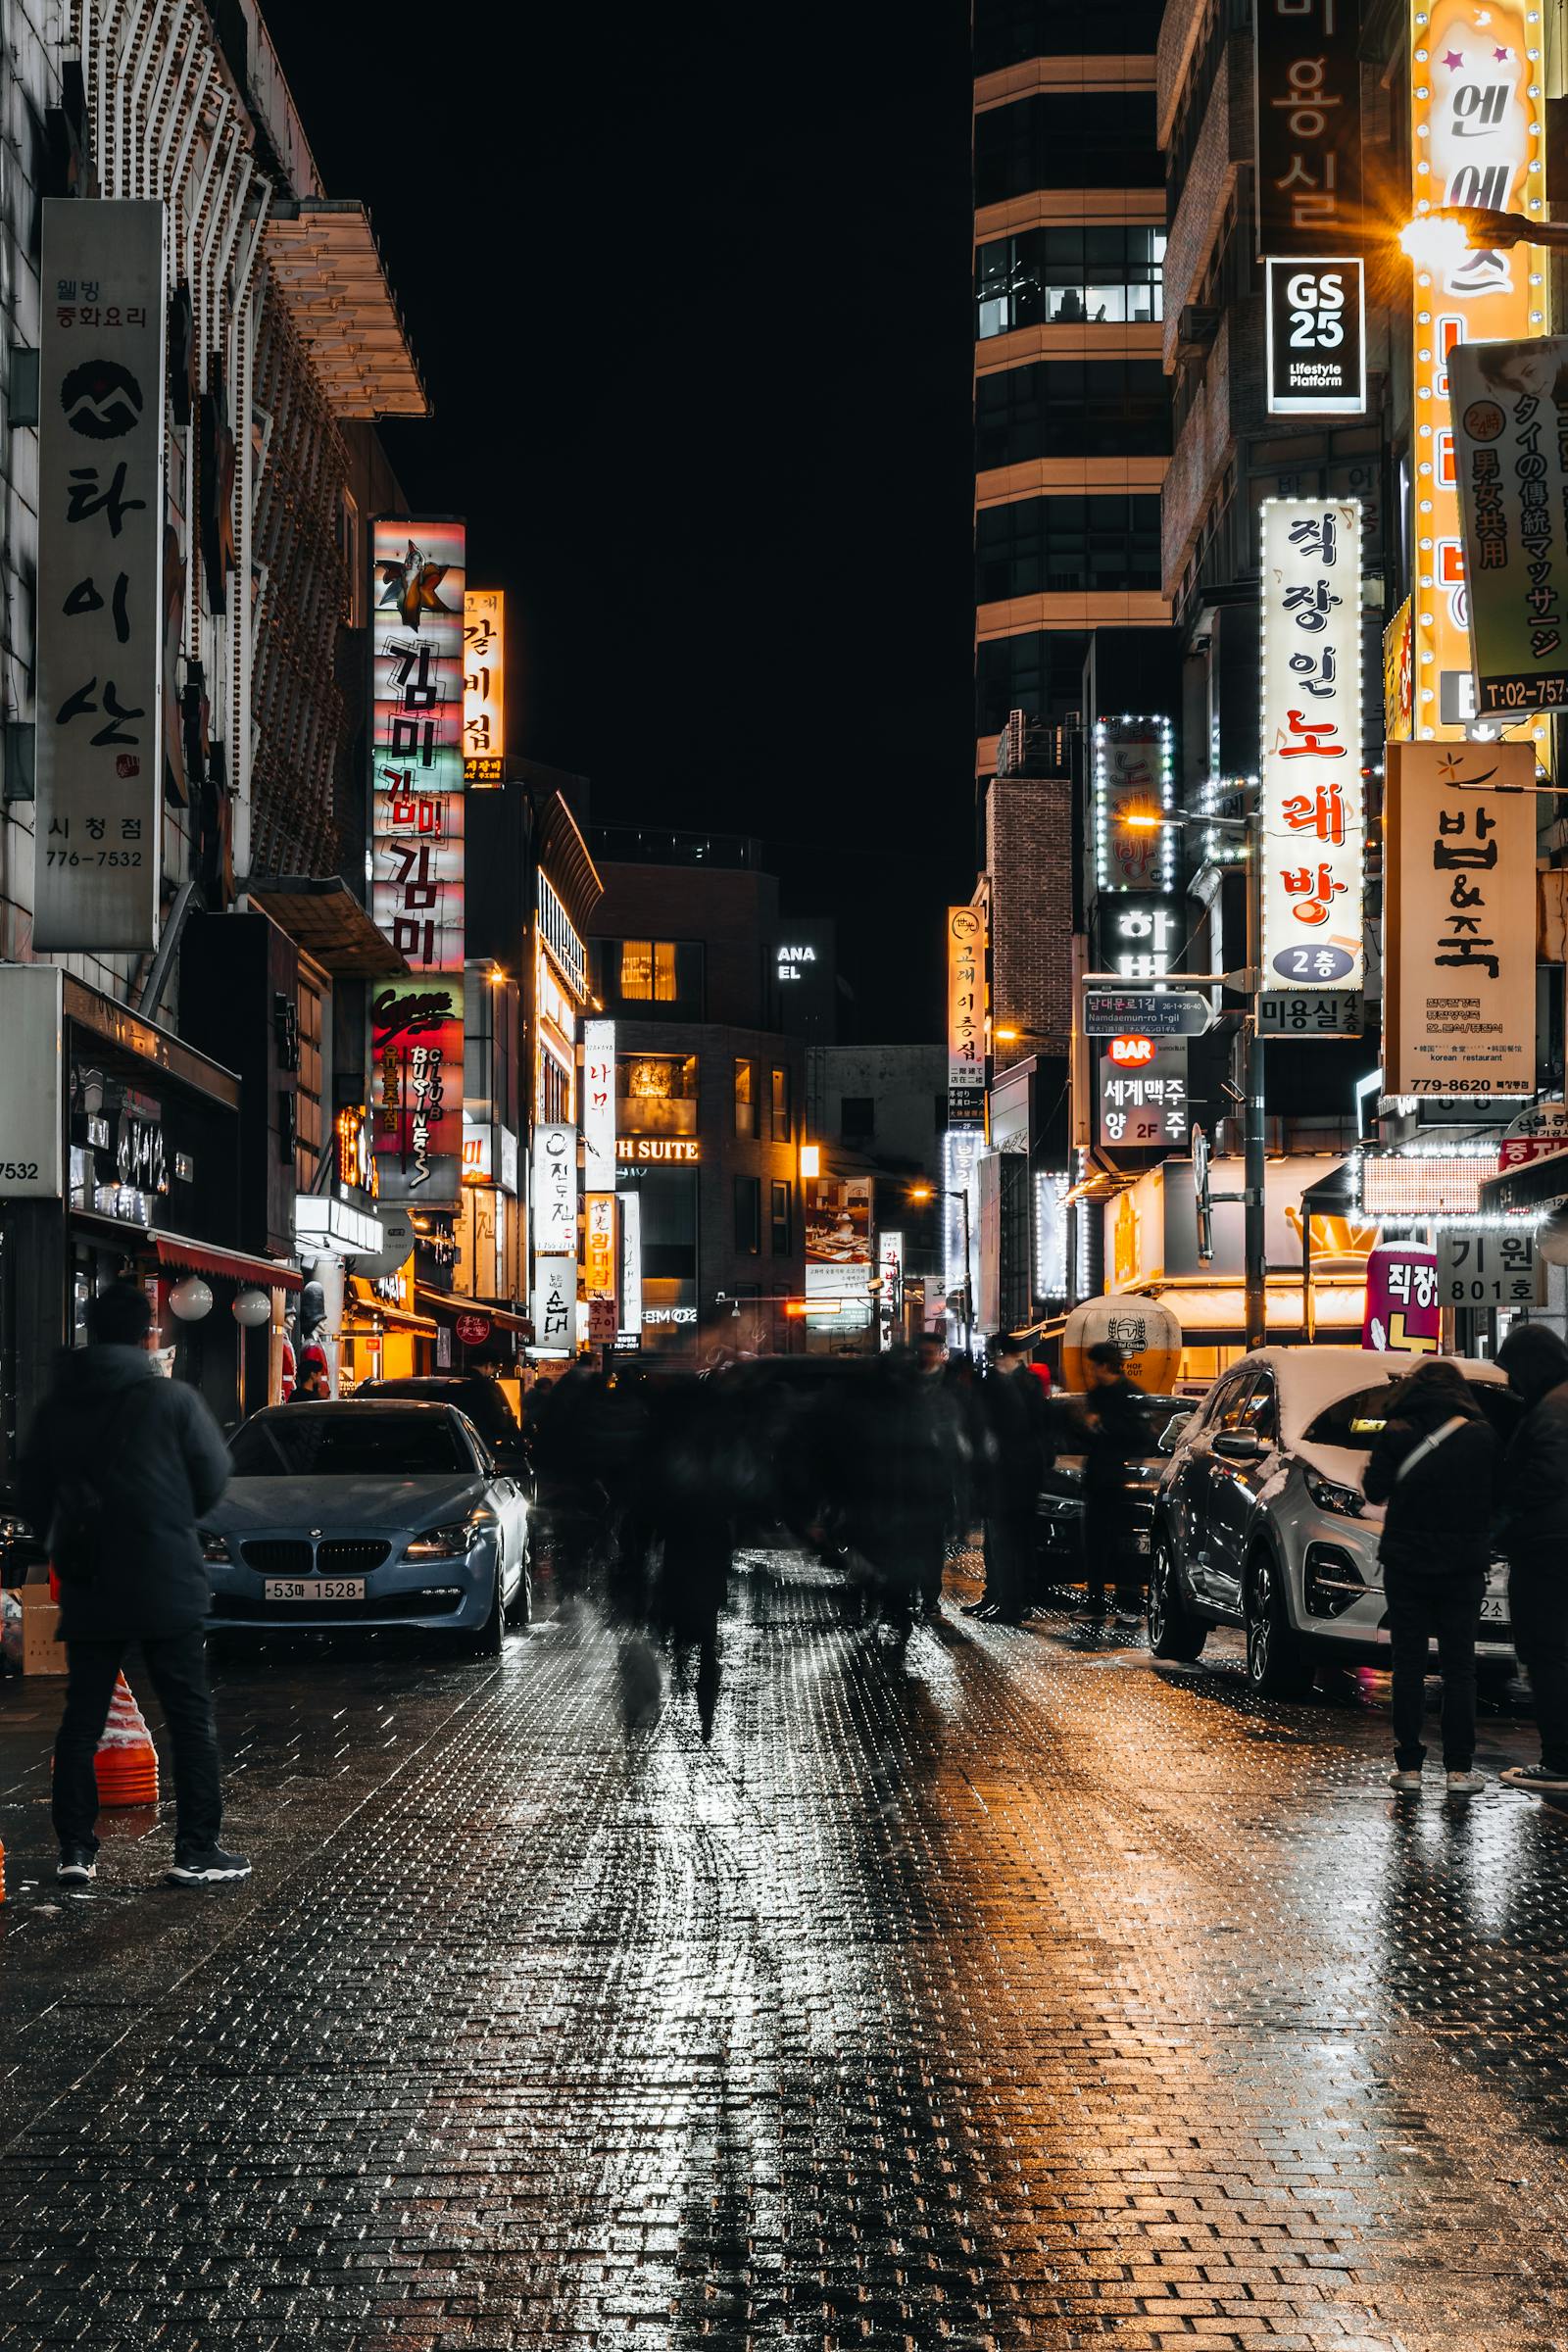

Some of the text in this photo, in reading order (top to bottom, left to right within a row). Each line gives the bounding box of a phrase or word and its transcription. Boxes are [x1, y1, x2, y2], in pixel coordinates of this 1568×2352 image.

[56, 278, 100, 301] 웰빙
[1287, 273, 1345, 311] GS
[56, 305, 147, 328] 중화요리
[1289, 311, 1345, 348] 25
[1290, 364, 1342, 376] Lifestyle
[1290, 375, 1343, 386] Platform
[56, 461, 146, 748] 타이산
[1282, 513, 1342, 697] 직장인
[1487, 679, 1568, 708] T:02-757
[47, 817, 142, 840] 시청점
[1278, 710, 1347, 926] 노래방
[46, 850, 143, 867] 776-7532
[1434, 808, 1499, 978] 밥&죽
[778, 948, 815, 960] ANA
[1293, 951, 1336, 978] 2층
[778, 965, 801, 979] EL
[1089, 998, 1155, 1011] 남대문로1길
[1261, 1001, 1339, 1029] 미용실
[1160, 1013, 1180, 1024] 1-gil
[1112, 1041, 1152, 1059] BAR
[381, 1045, 400, 1133] 유흥주점
[427, 1047, 445, 1122] CLUB
[1103, 1079, 1186, 1106] 세계맥주
[1410, 1079, 1492, 1092] 779-8620
[411, 1045, 431, 1190] BUSINESS
[1104, 1111, 1187, 1140] 양 2F 주
[638, 1140, 699, 1159] SUITE
[1451, 1237, 1533, 1273] 기원
[1388, 1264, 1438, 1307] 직장
[1451, 1280, 1533, 1300] 801호
[590, 1316, 615, 1331] 구이
[273, 1582, 356, 1597] 53마 1528
